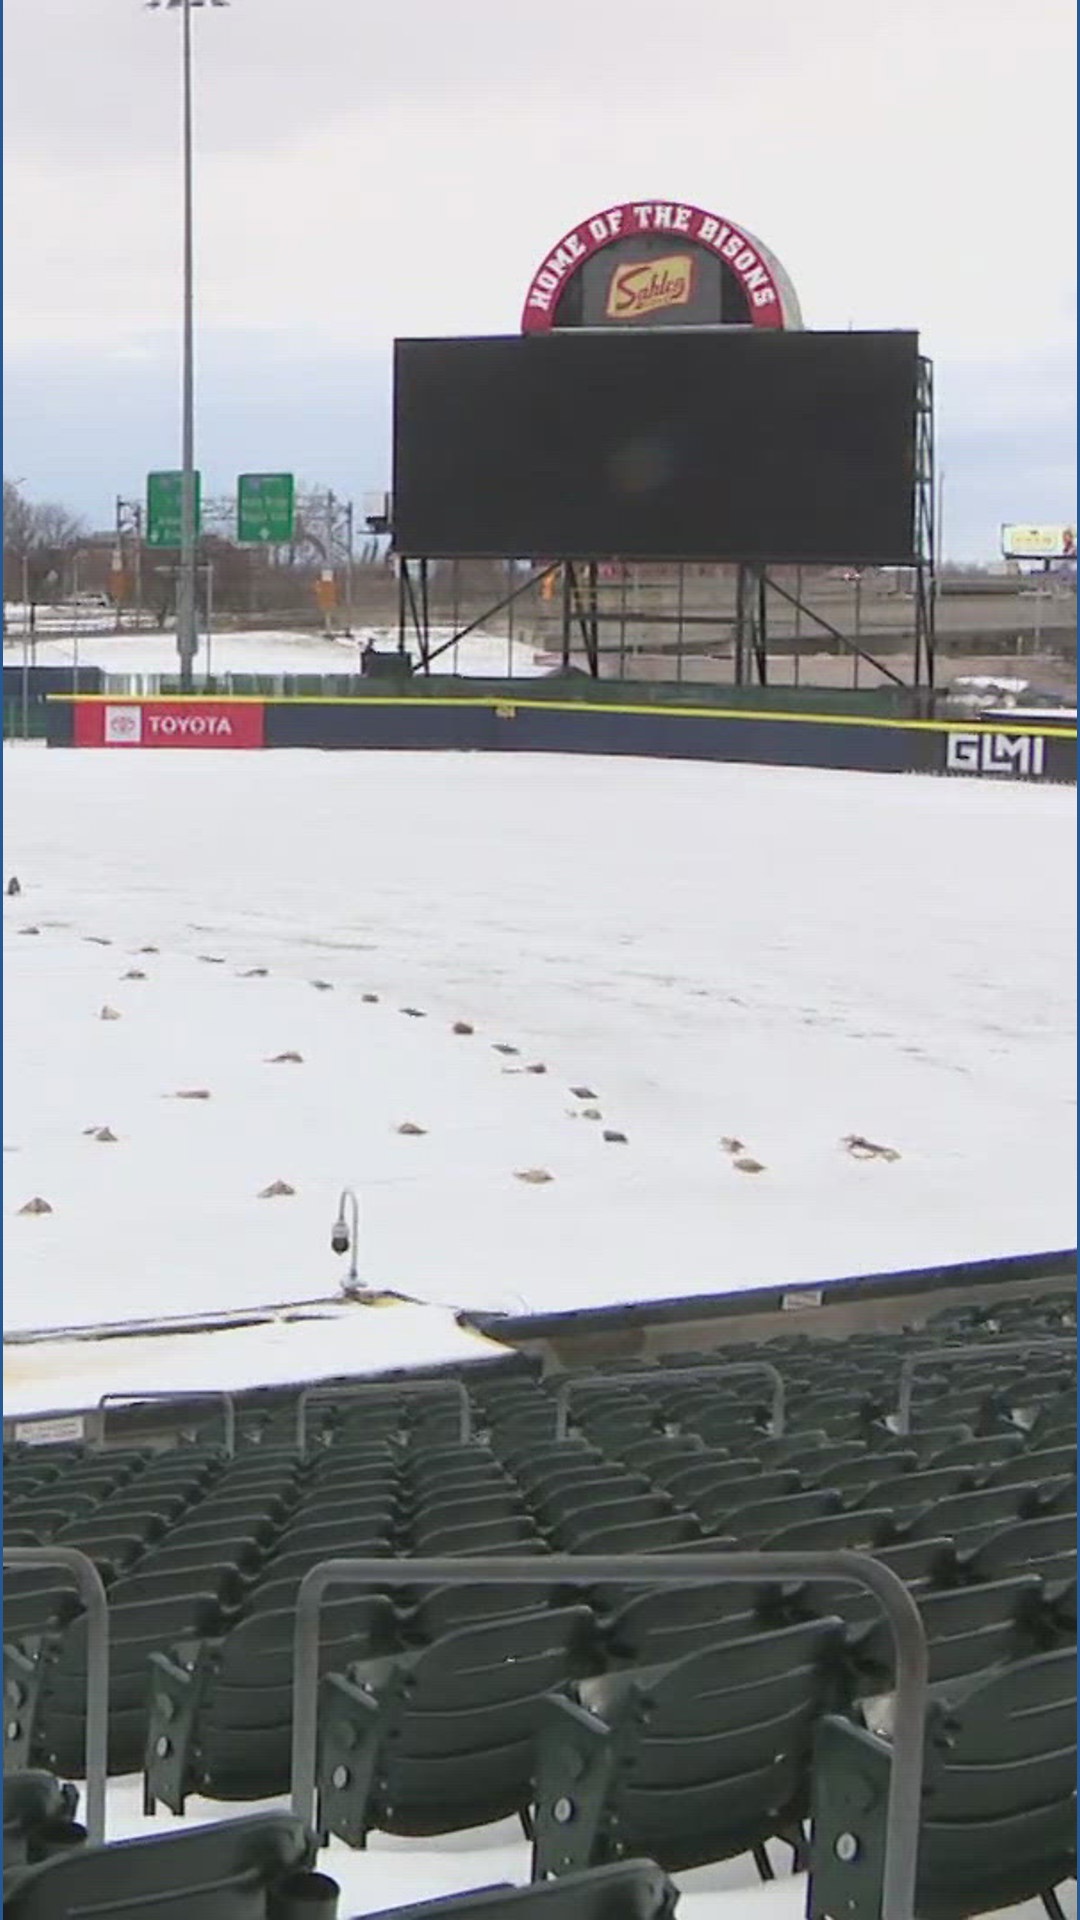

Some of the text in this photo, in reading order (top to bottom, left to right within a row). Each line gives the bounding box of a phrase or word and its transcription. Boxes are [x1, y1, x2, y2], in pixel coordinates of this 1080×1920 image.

[529, 204, 776, 311] HOME OF THE BISONS
[149, 716, 232, 735] TOYOTA
[947, 733, 1043, 774] GLMI
